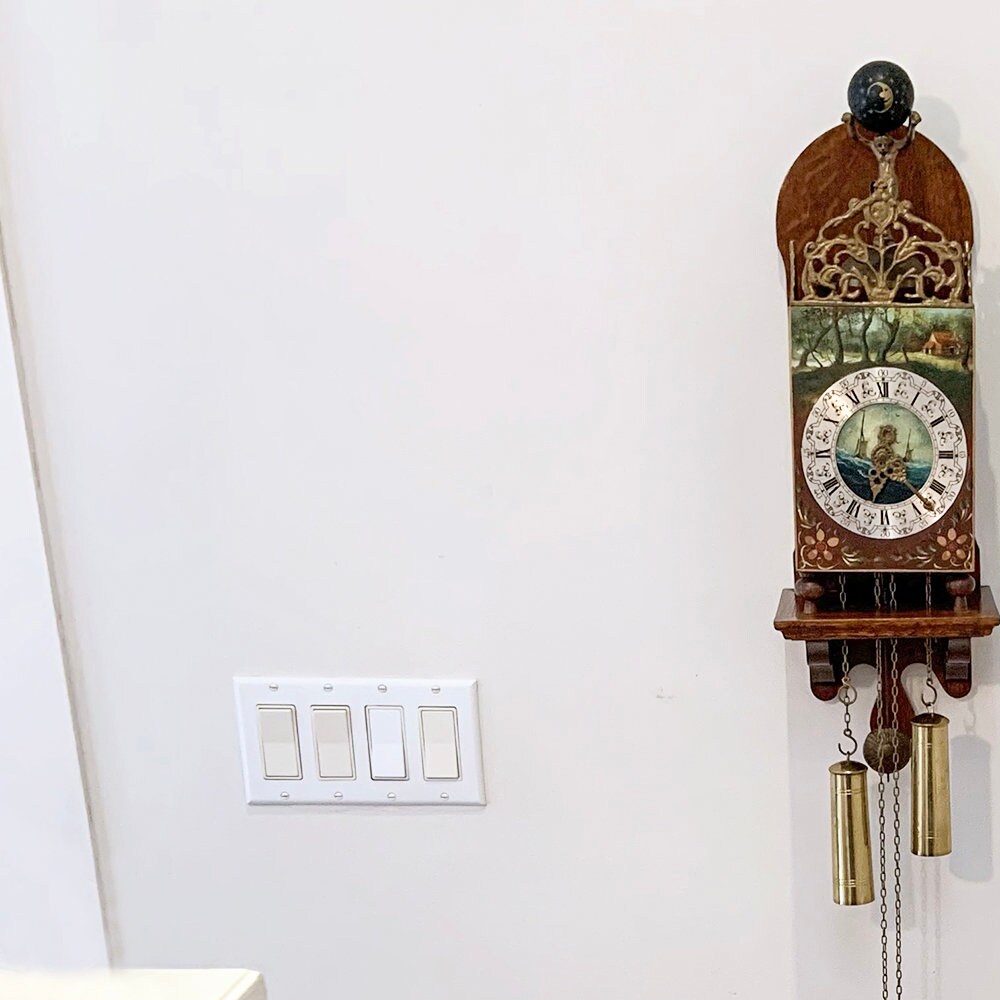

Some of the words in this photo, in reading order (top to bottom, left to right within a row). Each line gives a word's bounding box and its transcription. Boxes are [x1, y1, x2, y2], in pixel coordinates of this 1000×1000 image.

[930, 415, 945, 428] II
[938, 450, 954, 459] III
[929, 479, 946, 495] IIII
